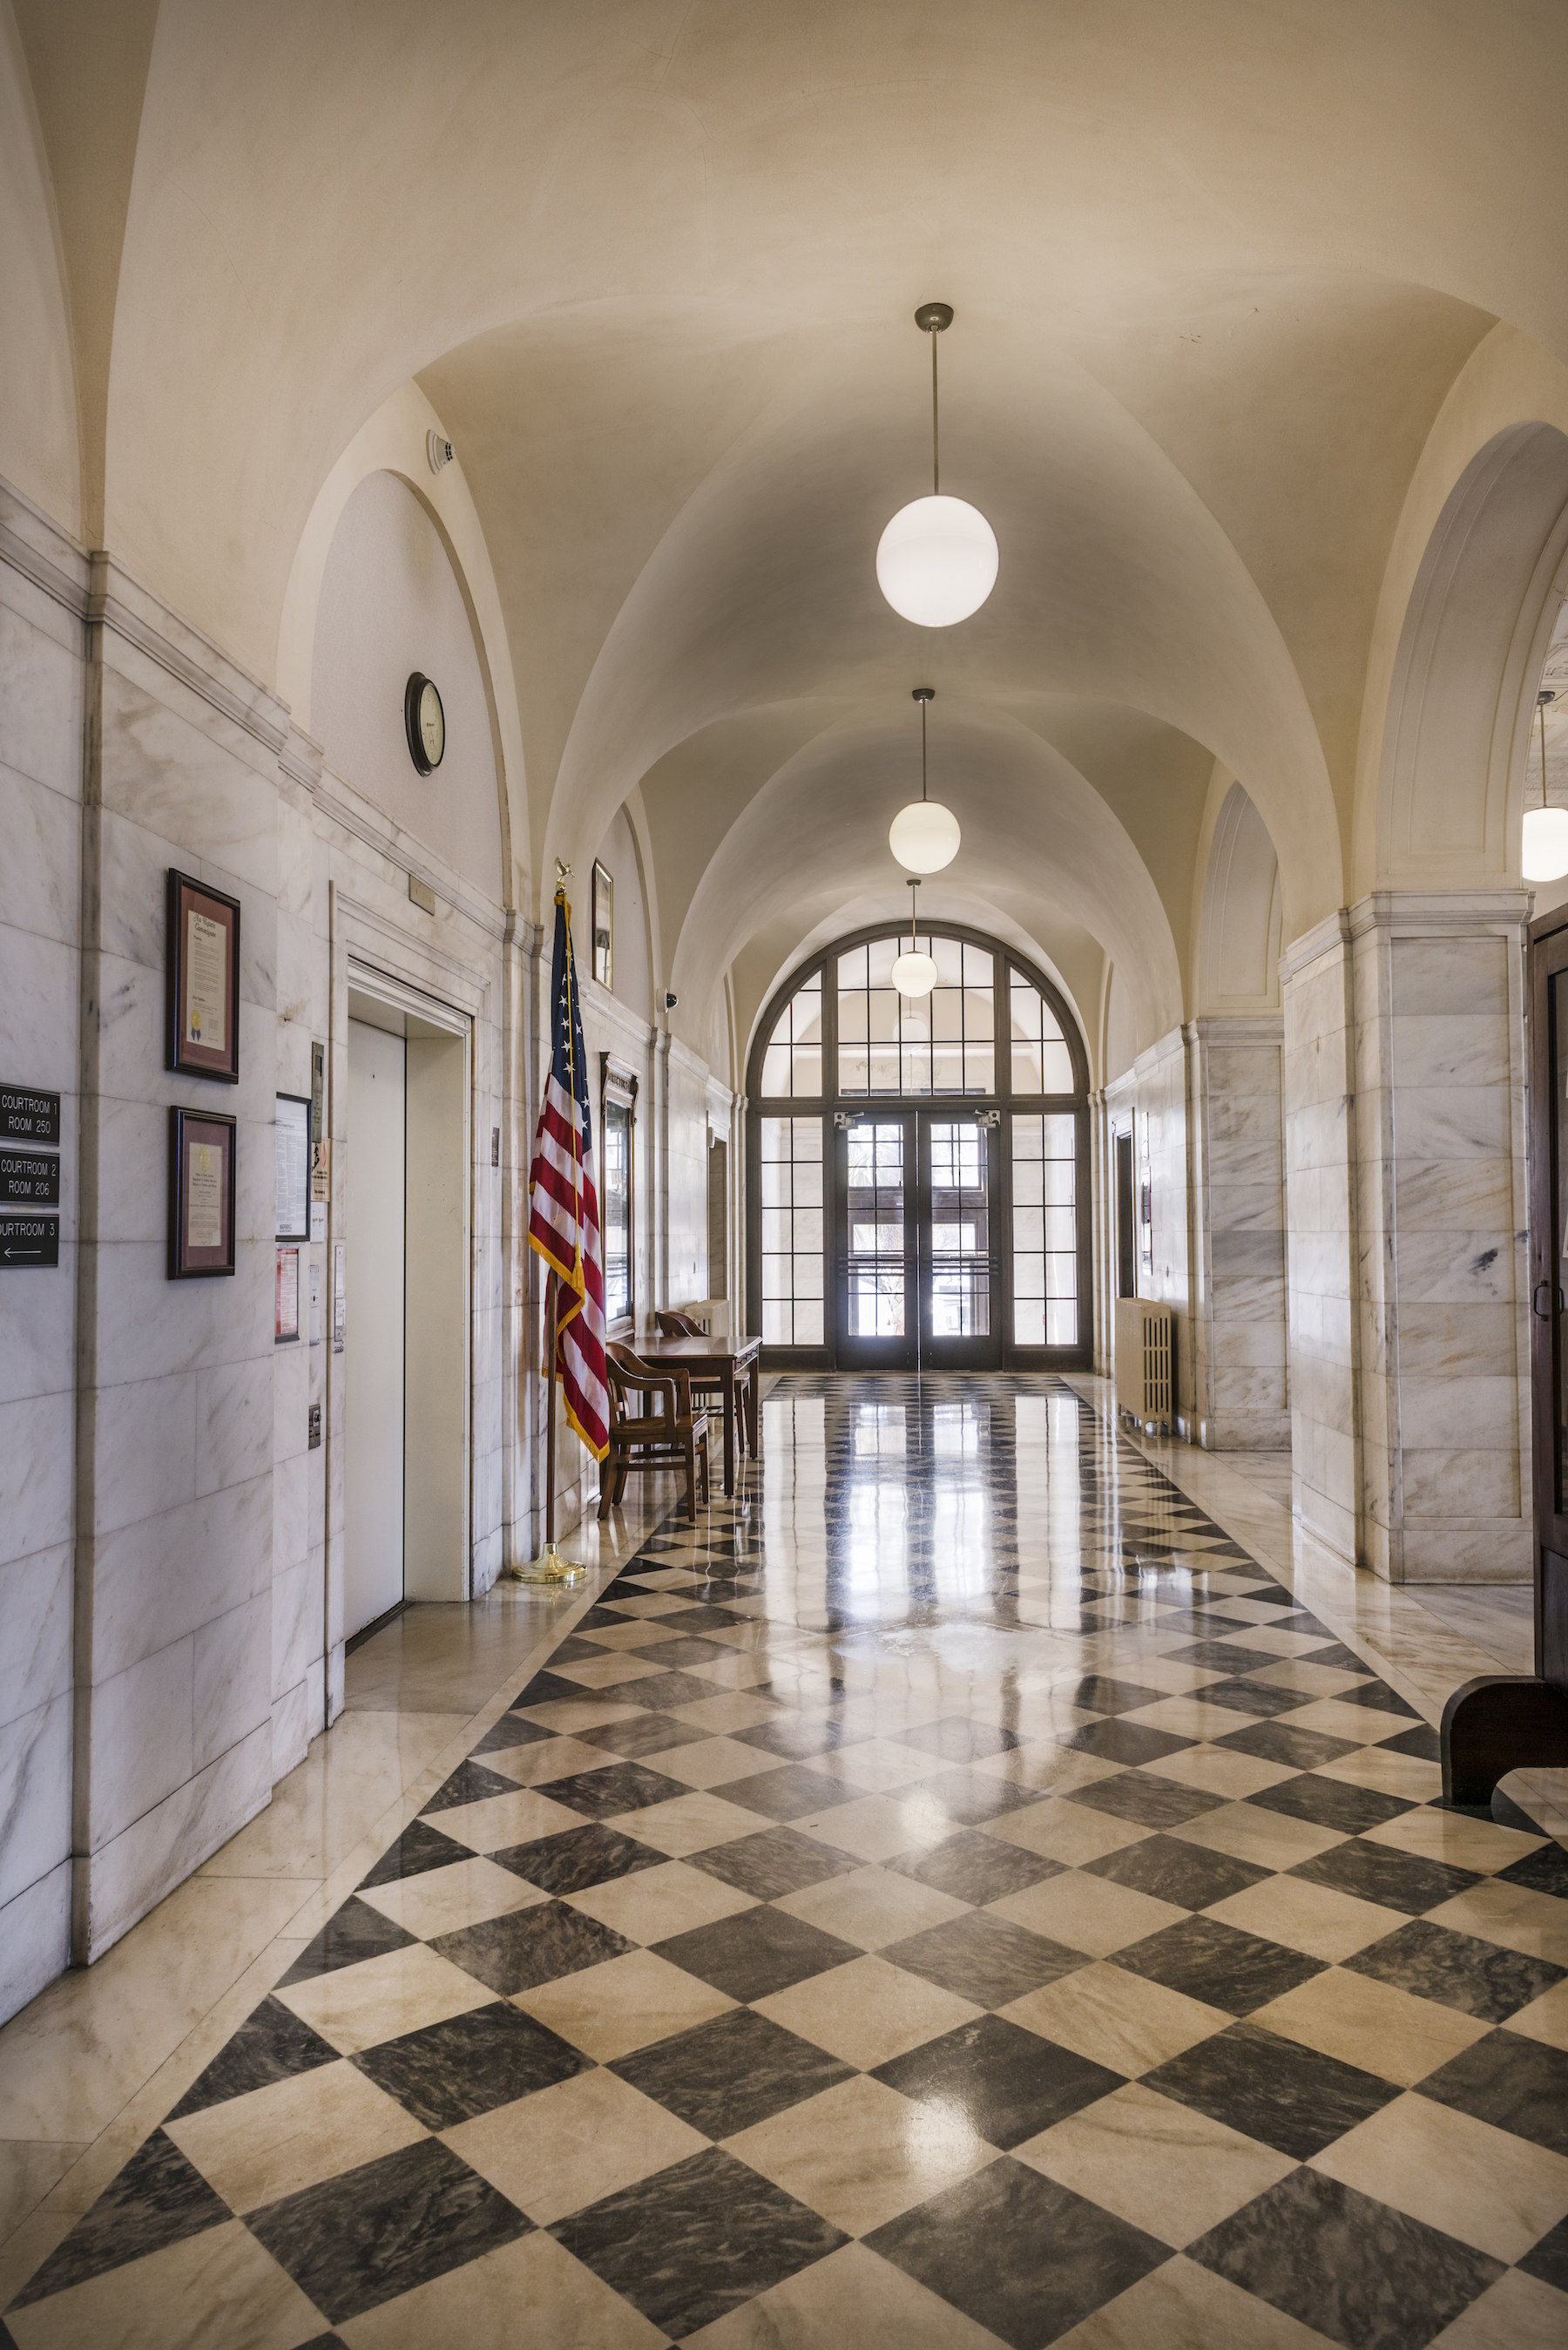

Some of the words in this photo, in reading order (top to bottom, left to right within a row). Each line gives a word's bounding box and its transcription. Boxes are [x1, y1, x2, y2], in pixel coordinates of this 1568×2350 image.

[2, 1094, 50, 1114] COURTROOM
[53, 1102, 57, 1114] 1
[9, 1115, 32, 1131] ROOM
[36, 1120, 51, 1134] 250
[1, 1159, 48, 1175] COURTROOM
[51, 1163, 56, 1176] 2
[9, 1180, 31, 1194] ROOM
[35, 1182, 50, 1195] 206
[0, 1222, 44, 1236] URTROOM
[50, 1222, 55, 1236] 3
